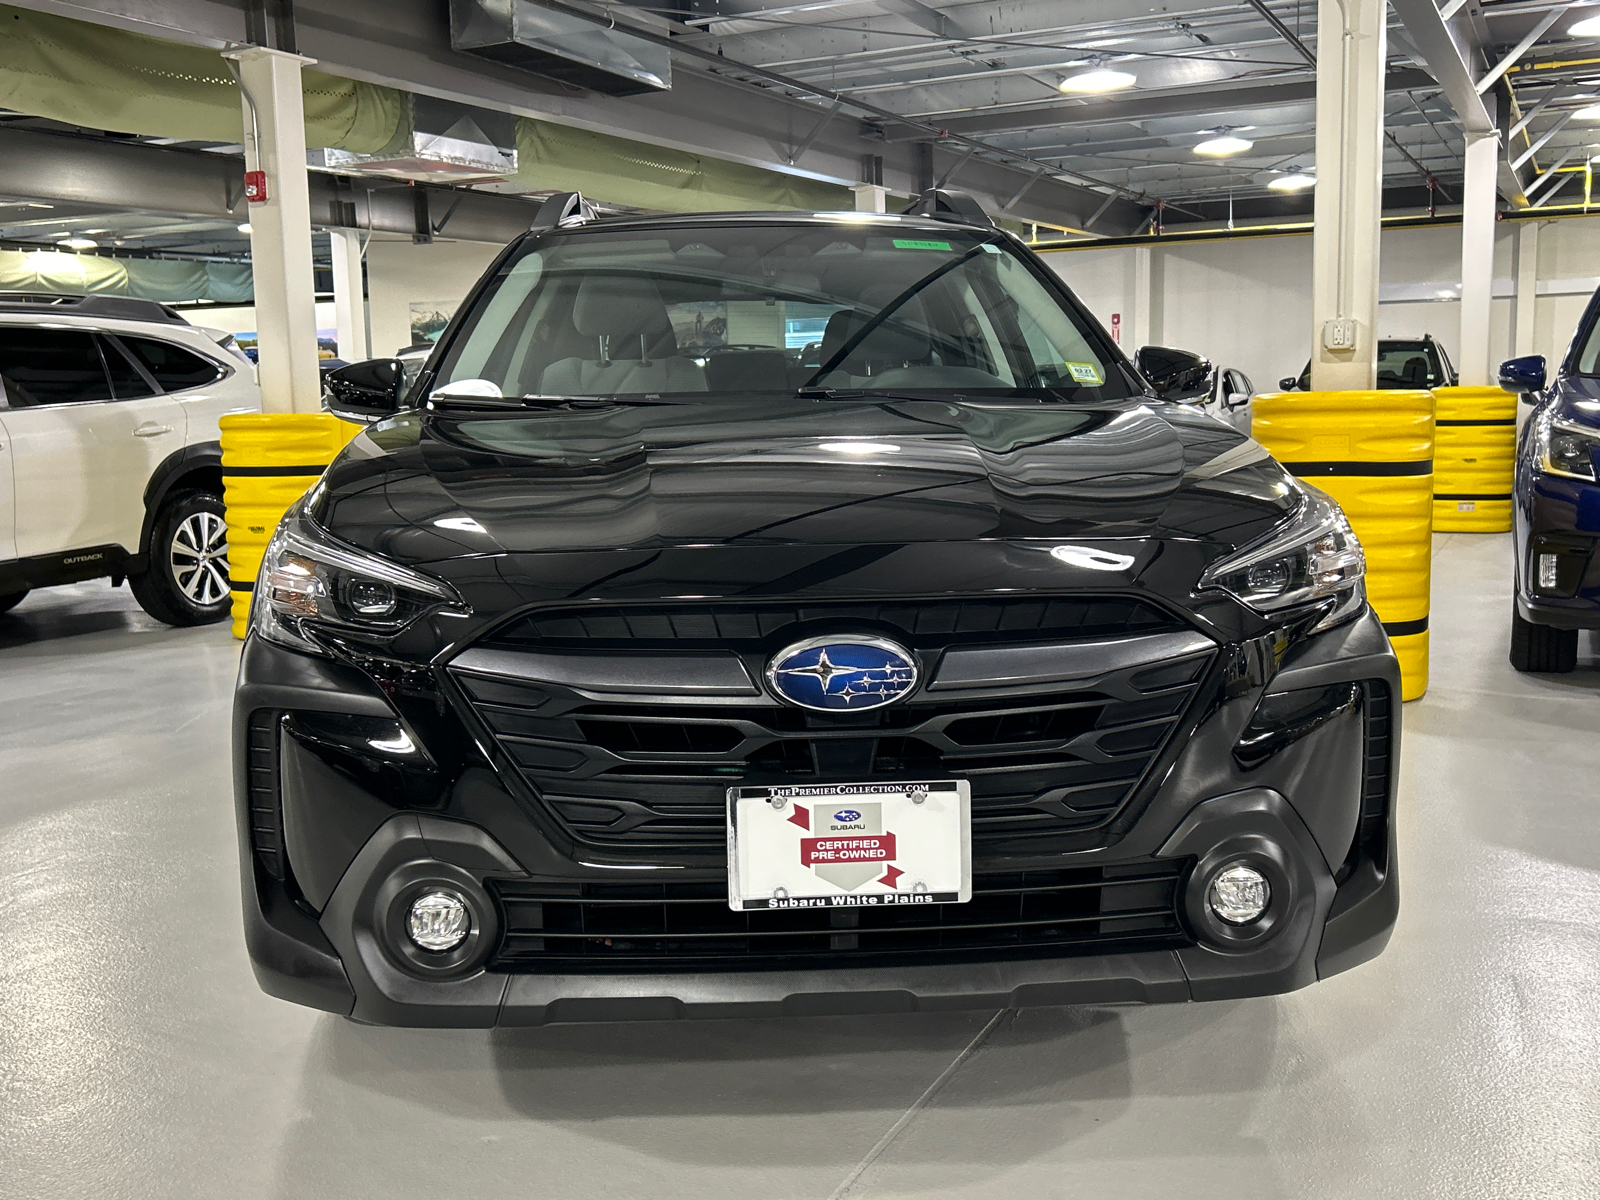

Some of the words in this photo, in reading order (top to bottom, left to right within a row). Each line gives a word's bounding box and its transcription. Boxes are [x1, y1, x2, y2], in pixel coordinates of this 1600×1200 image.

[63, 553, 103, 564] OUTBACK
[816, 840, 880, 850] CERTIFIED
[811, 849, 886, 860] PRE-OWNED
[768, 898, 826, 908] Subaru
[830, 895, 878, 906] White
[884, 893, 933, 904] Plains
